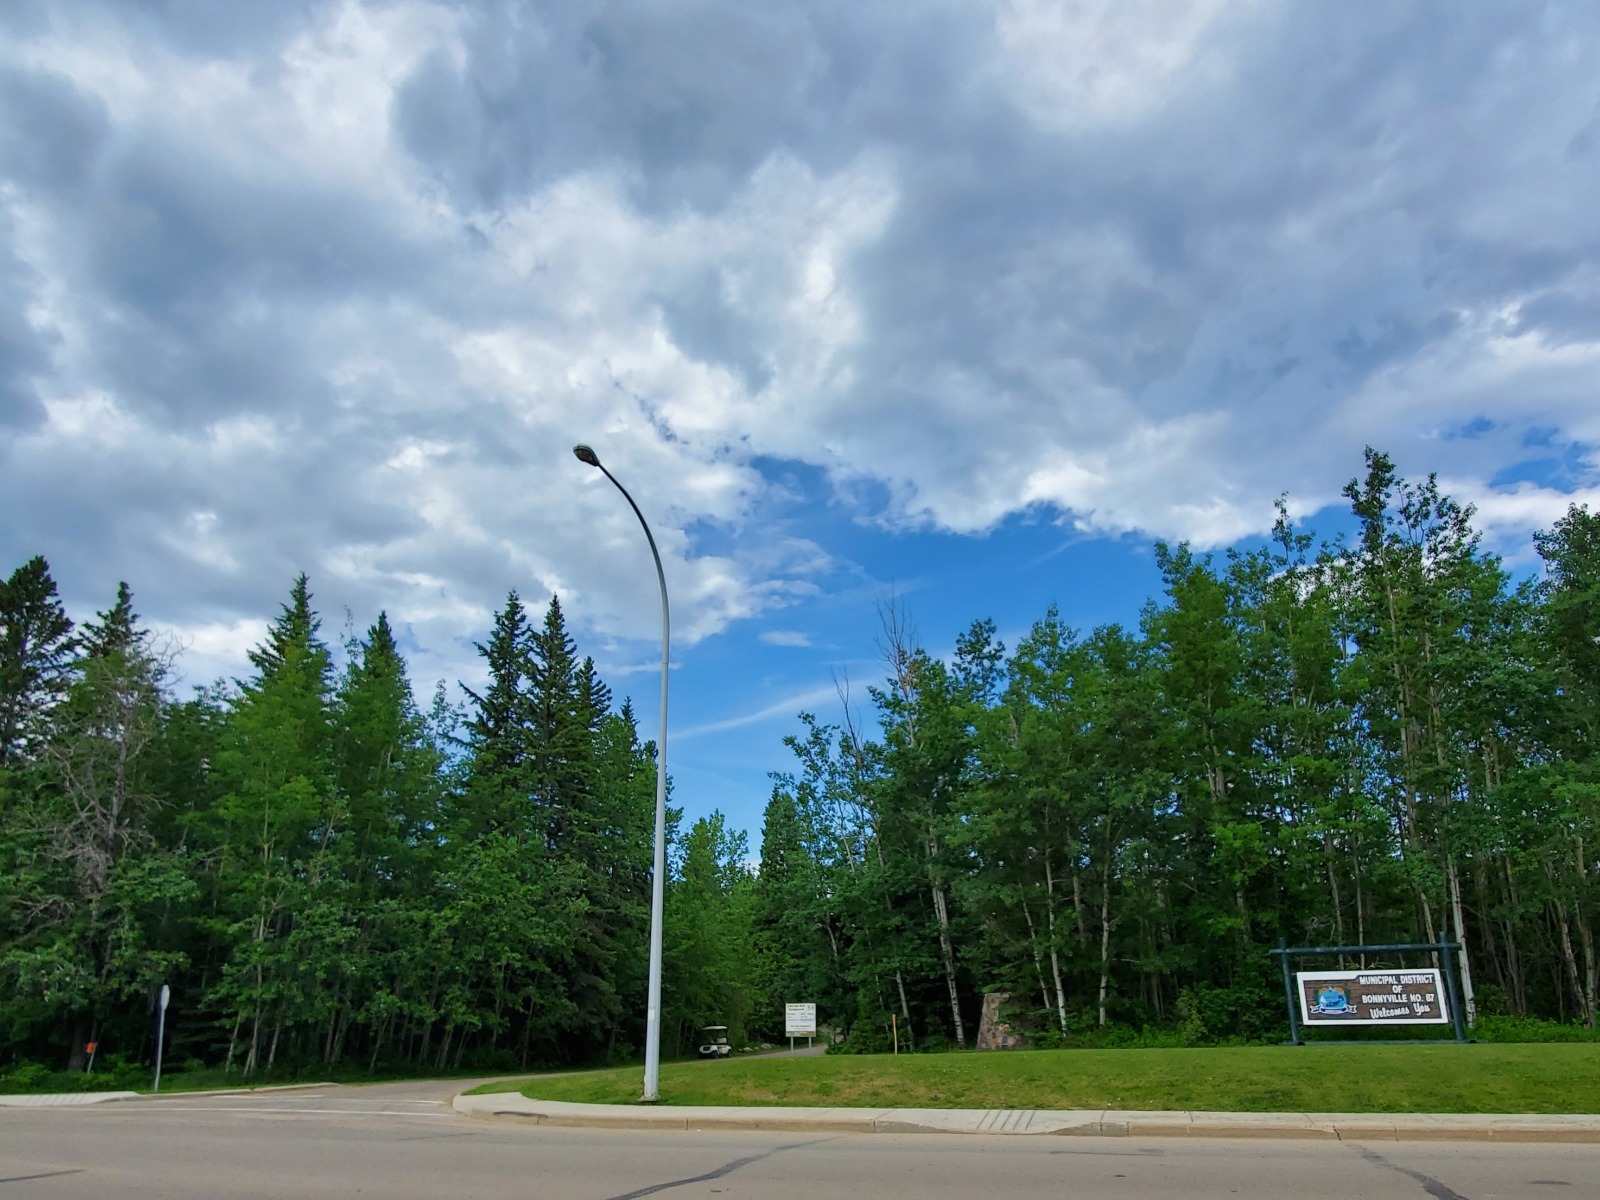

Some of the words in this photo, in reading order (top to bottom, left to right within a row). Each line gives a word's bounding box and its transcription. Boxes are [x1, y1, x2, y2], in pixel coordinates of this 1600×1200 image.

[1359, 975, 1398, 984] MUNICIPAL
[1400, 974, 1433, 984] DISTRICT
[1392, 985, 1402, 993] OF
[1361, 993, 1408, 1003] BONNYVILLE
[1425, 993, 1435, 1002] 87
[1369, 1006, 1410, 1019] Welcomes
[1413, 1002, 1431, 1016] You
